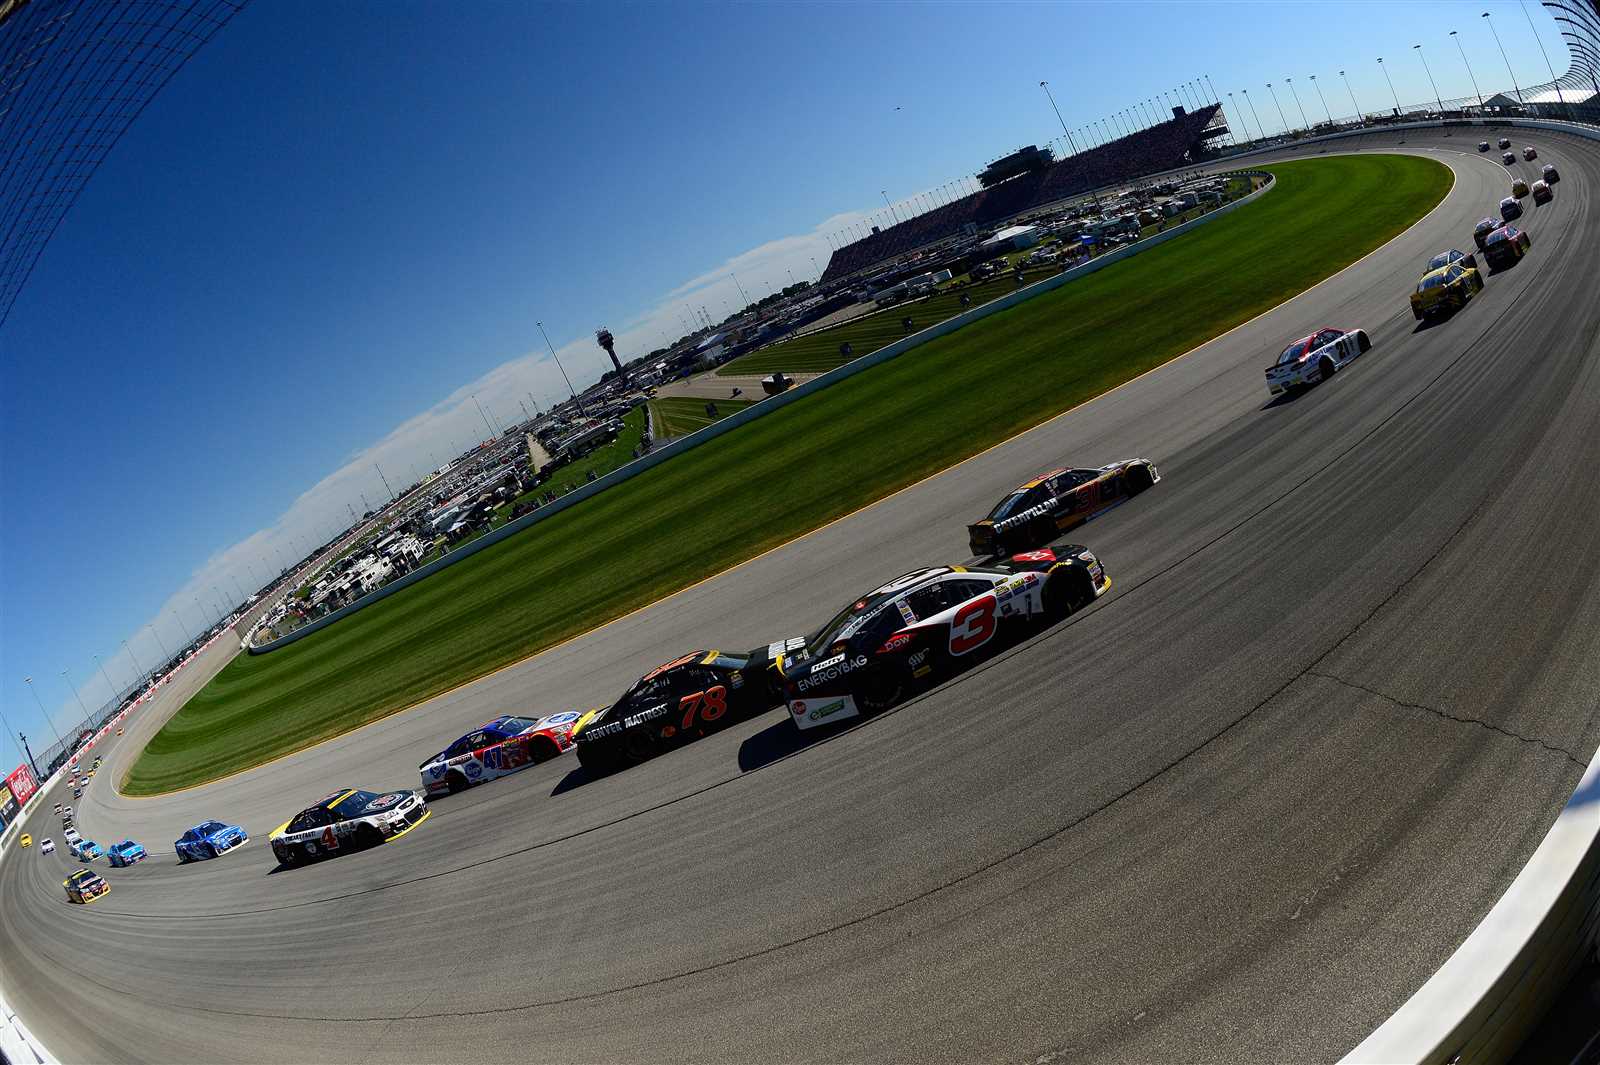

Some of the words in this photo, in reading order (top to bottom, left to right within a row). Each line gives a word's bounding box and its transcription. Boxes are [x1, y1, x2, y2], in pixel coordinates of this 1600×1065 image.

[993, 497, 1060, 534] CATERPILLAR
[949, 594, 998, 657] 3
[797, 654, 868, 692] ENERGYBAG
[585, 720, 623, 742] DENVER
[624, 703, 669, 729] MATTRESS
[678, 685, 728, 729] 78
[320, 825, 339, 850] 4
